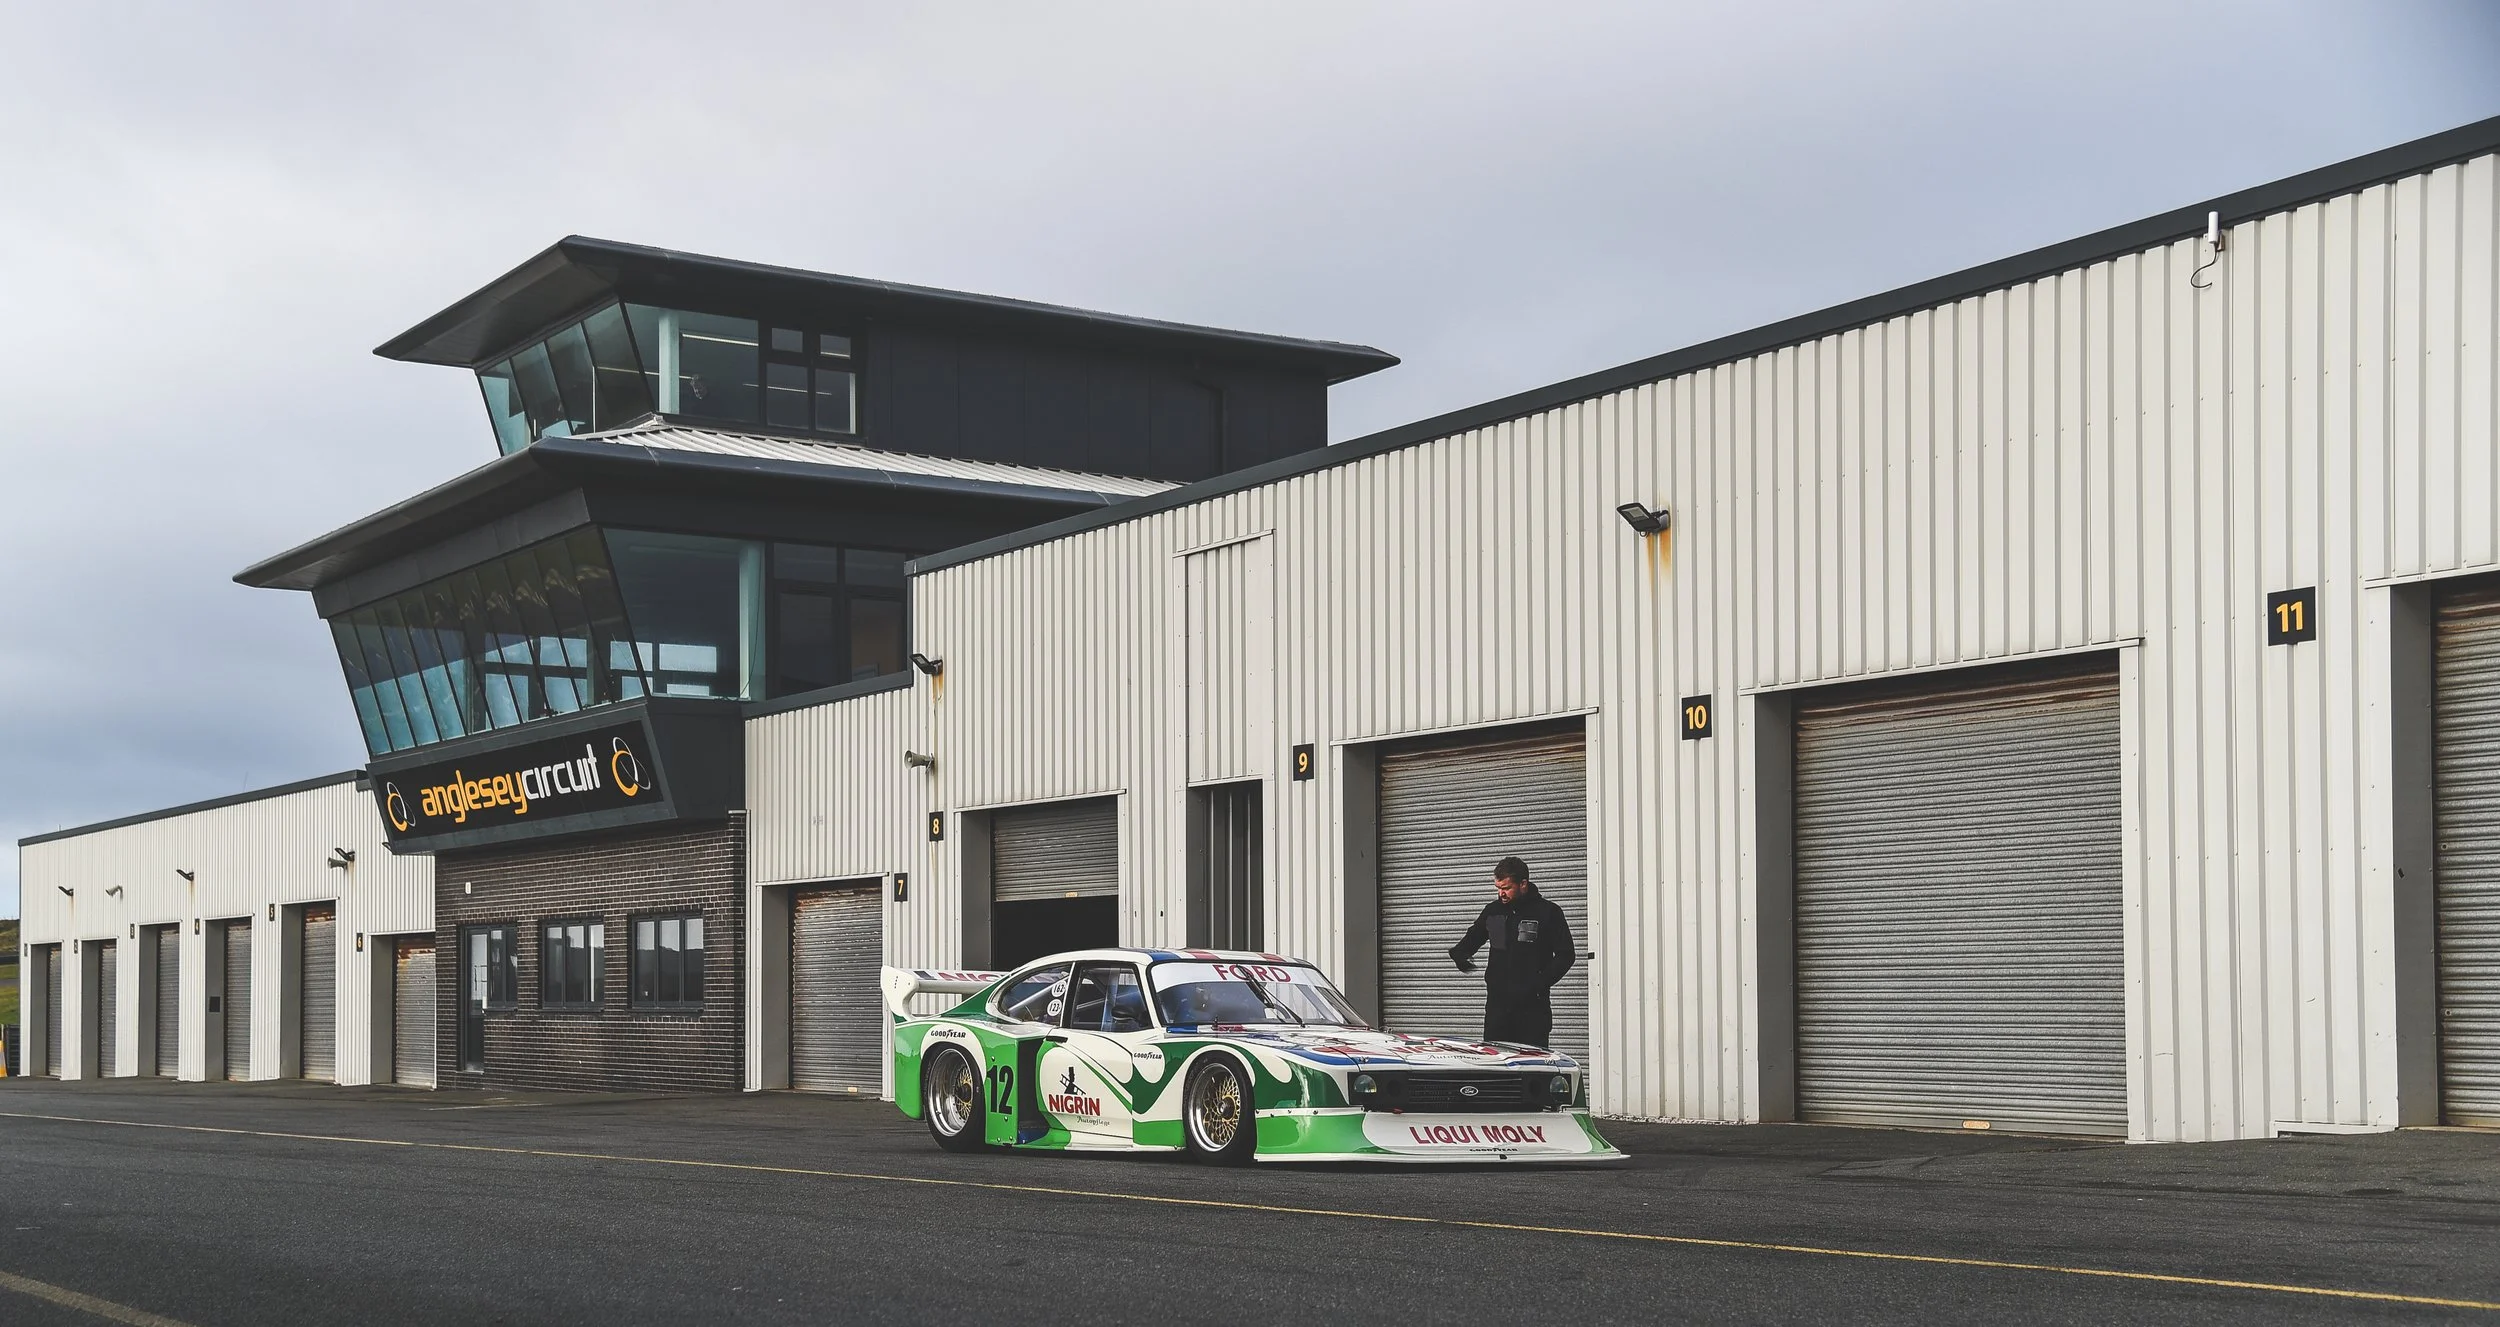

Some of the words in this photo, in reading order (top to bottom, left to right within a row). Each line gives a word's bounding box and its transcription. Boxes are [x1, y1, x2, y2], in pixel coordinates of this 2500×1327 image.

[2276, 601, 2303, 632] 11
[1686, 705, 1707, 729] 10
[1299, 752, 1308, 772] 9
[933, 818, 940, 834] 8
[898, 880, 904, 895] 7
[357, 937, 362, 948] 6
[1212, 964, 1291, 982] FORD
[930, 1028, 966, 1039] GOODYEAR
[1134, 1051, 1162, 1060] GOODYEAR
[986, 1065, 1014, 1115] 12
[1048, 1093, 1100, 1116] NIGRIN
[1409, 1125, 1480, 1144] LIQUI
[1481, 1125, 1547, 1143] MOLY
